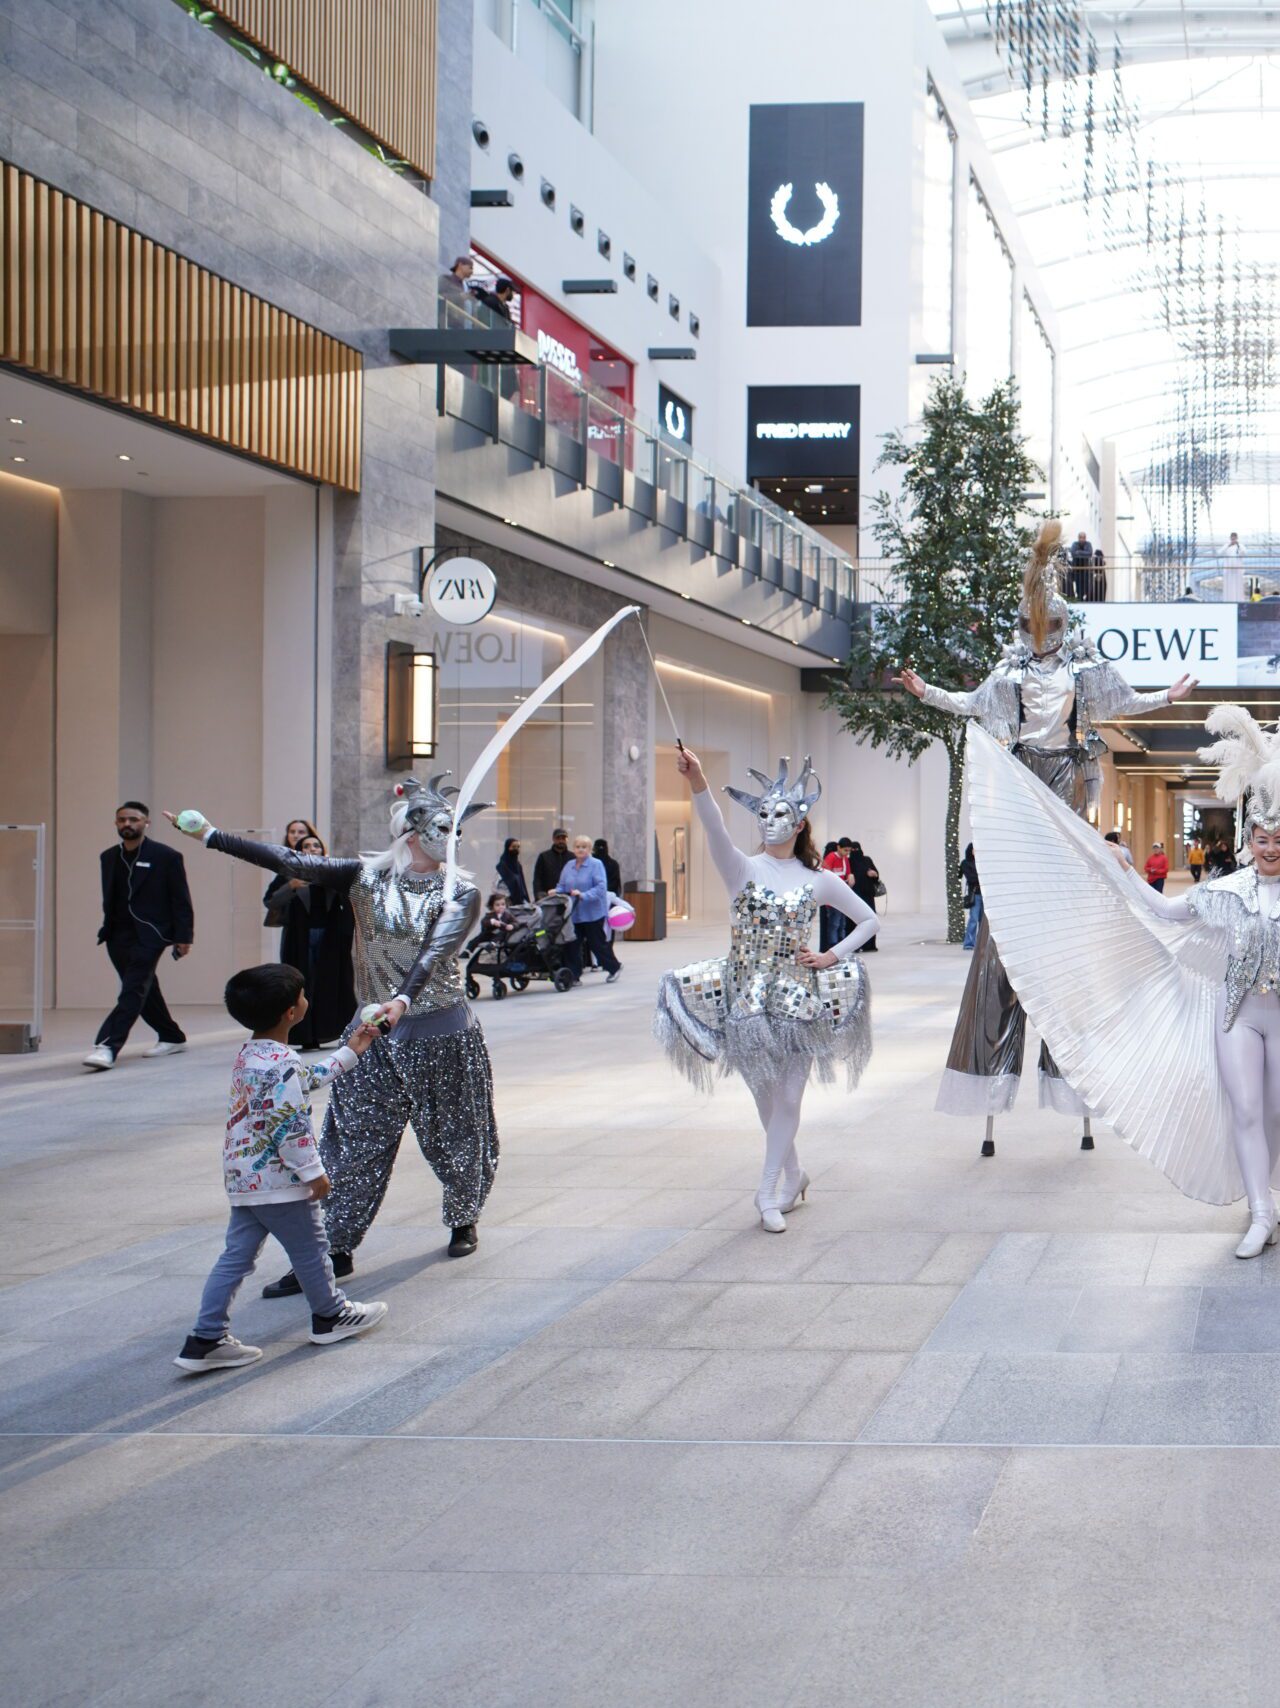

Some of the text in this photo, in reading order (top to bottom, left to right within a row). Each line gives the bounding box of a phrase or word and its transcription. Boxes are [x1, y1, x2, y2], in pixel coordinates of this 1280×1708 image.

[757, 422, 851, 438] FRED PERRY
[438, 578, 485, 600] ZARA
